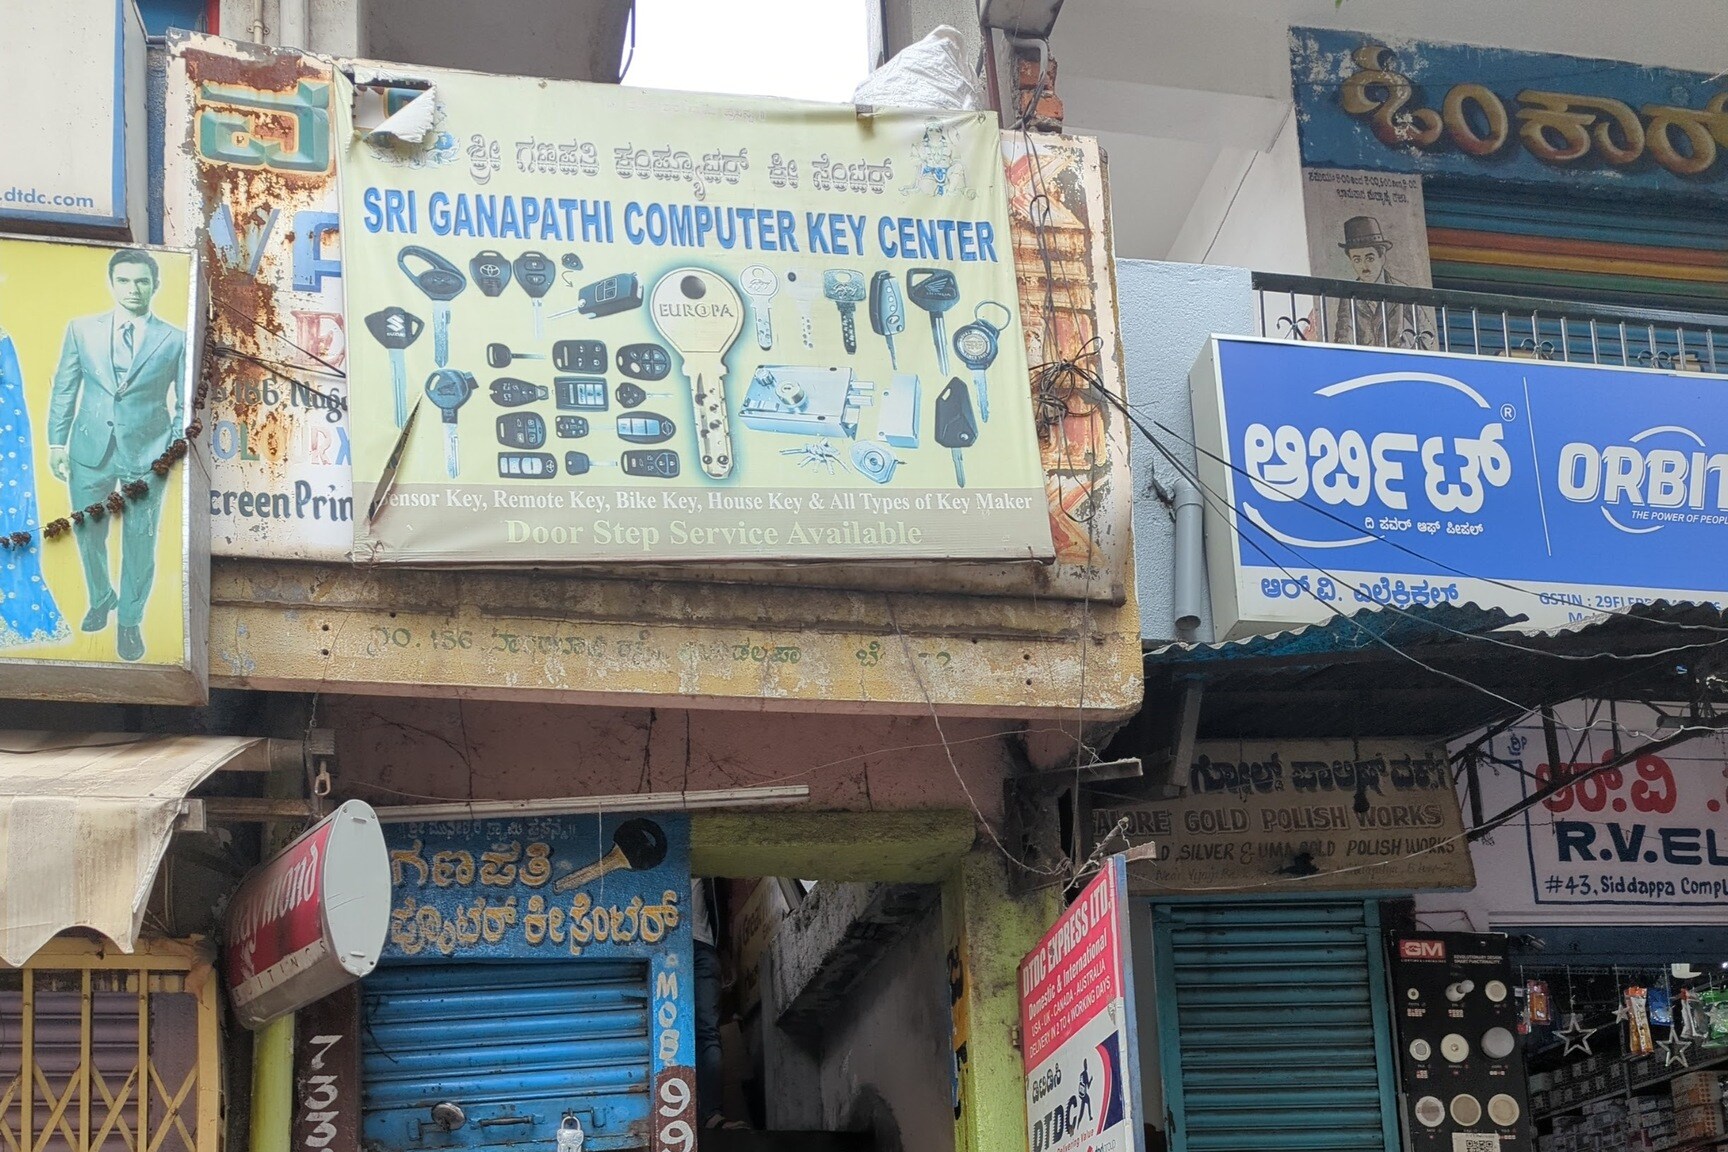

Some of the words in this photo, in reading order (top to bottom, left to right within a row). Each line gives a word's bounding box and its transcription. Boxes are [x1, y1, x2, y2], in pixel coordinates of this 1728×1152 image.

[466, 134, 501, 185] ಶ್ರೀ
[516, 135, 598, 177] ಗಣಪತಿ
[812, 153, 894, 195] ಸೆಂಟರ್
[363, 187, 417, 234] SRI
[428, 191, 614, 244] GANAPATHI
[624, 201, 800, 254] COMPUTER
[806, 212, 867, 256] KEY
[878, 215, 998, 263] CENTER
[446, 489, 488, 512] Key,
[493, 489, 563, 509] Remote
[570, 490, 611, 513] Key,
[616, 490, 656, 509] Bike
[662, 491, 702, 513] Key,
[708, 492, 763, 511] House
[769, 493, 802, 514] Key
[809, 493, 825, 510] &
[830, 493, 855, 510] All
[860, 493, 910, 514] Types
[916, 493, 932, 510] of
[935, 494, 970, 515] Key
[976, 494, 1033, 511] Maker
[1631, 510, 1649, 520] THE
[1651, 511, 1685, 522] POWER
[1686, 514, 1699, 523] OF
[504, 520, 584, 545] Door
[593, 520, 660, 551] Step
[670, 520, 779, 546] Service
[787, 521, 923, 546] Available
[1379, 517, 1412, 532] ಪವರ್
[1539, 592, 1582, 606] GSTIN
[1184, 805, 1250, 837] GOLD
[1260, 805, 1350, 833] POLISH
[1357, 804, 1444, 831] WORKS
[1346, 838, 1400, 857] POLISH
[1405, 836, 1455, 856] WORKS
[391, 839, 552, 887] ಗಣಪತಿ
[1600, 876, 1675, 898] Siddappa
[1022, 947, 1046, 999] DTDC
[1048, 901, 1089, 974] EXPRESS
[1028, 983, 1056, 1021] Domestic
[1063, 927, 1108, 988] International
[1032, 1023, 1041, 1038] USA
[1053, 988, 1074, 1017] CANADA
[1076, 958, 1106, 996] AUSTRALIA
[1029, 1035, 1051, 1059] DELIVERY
[1071, 989, 1096, 1022] WORKING
[1095, 975, 1111, 1000] DAYS
[1080, 1129, 1094, 1145] Value
